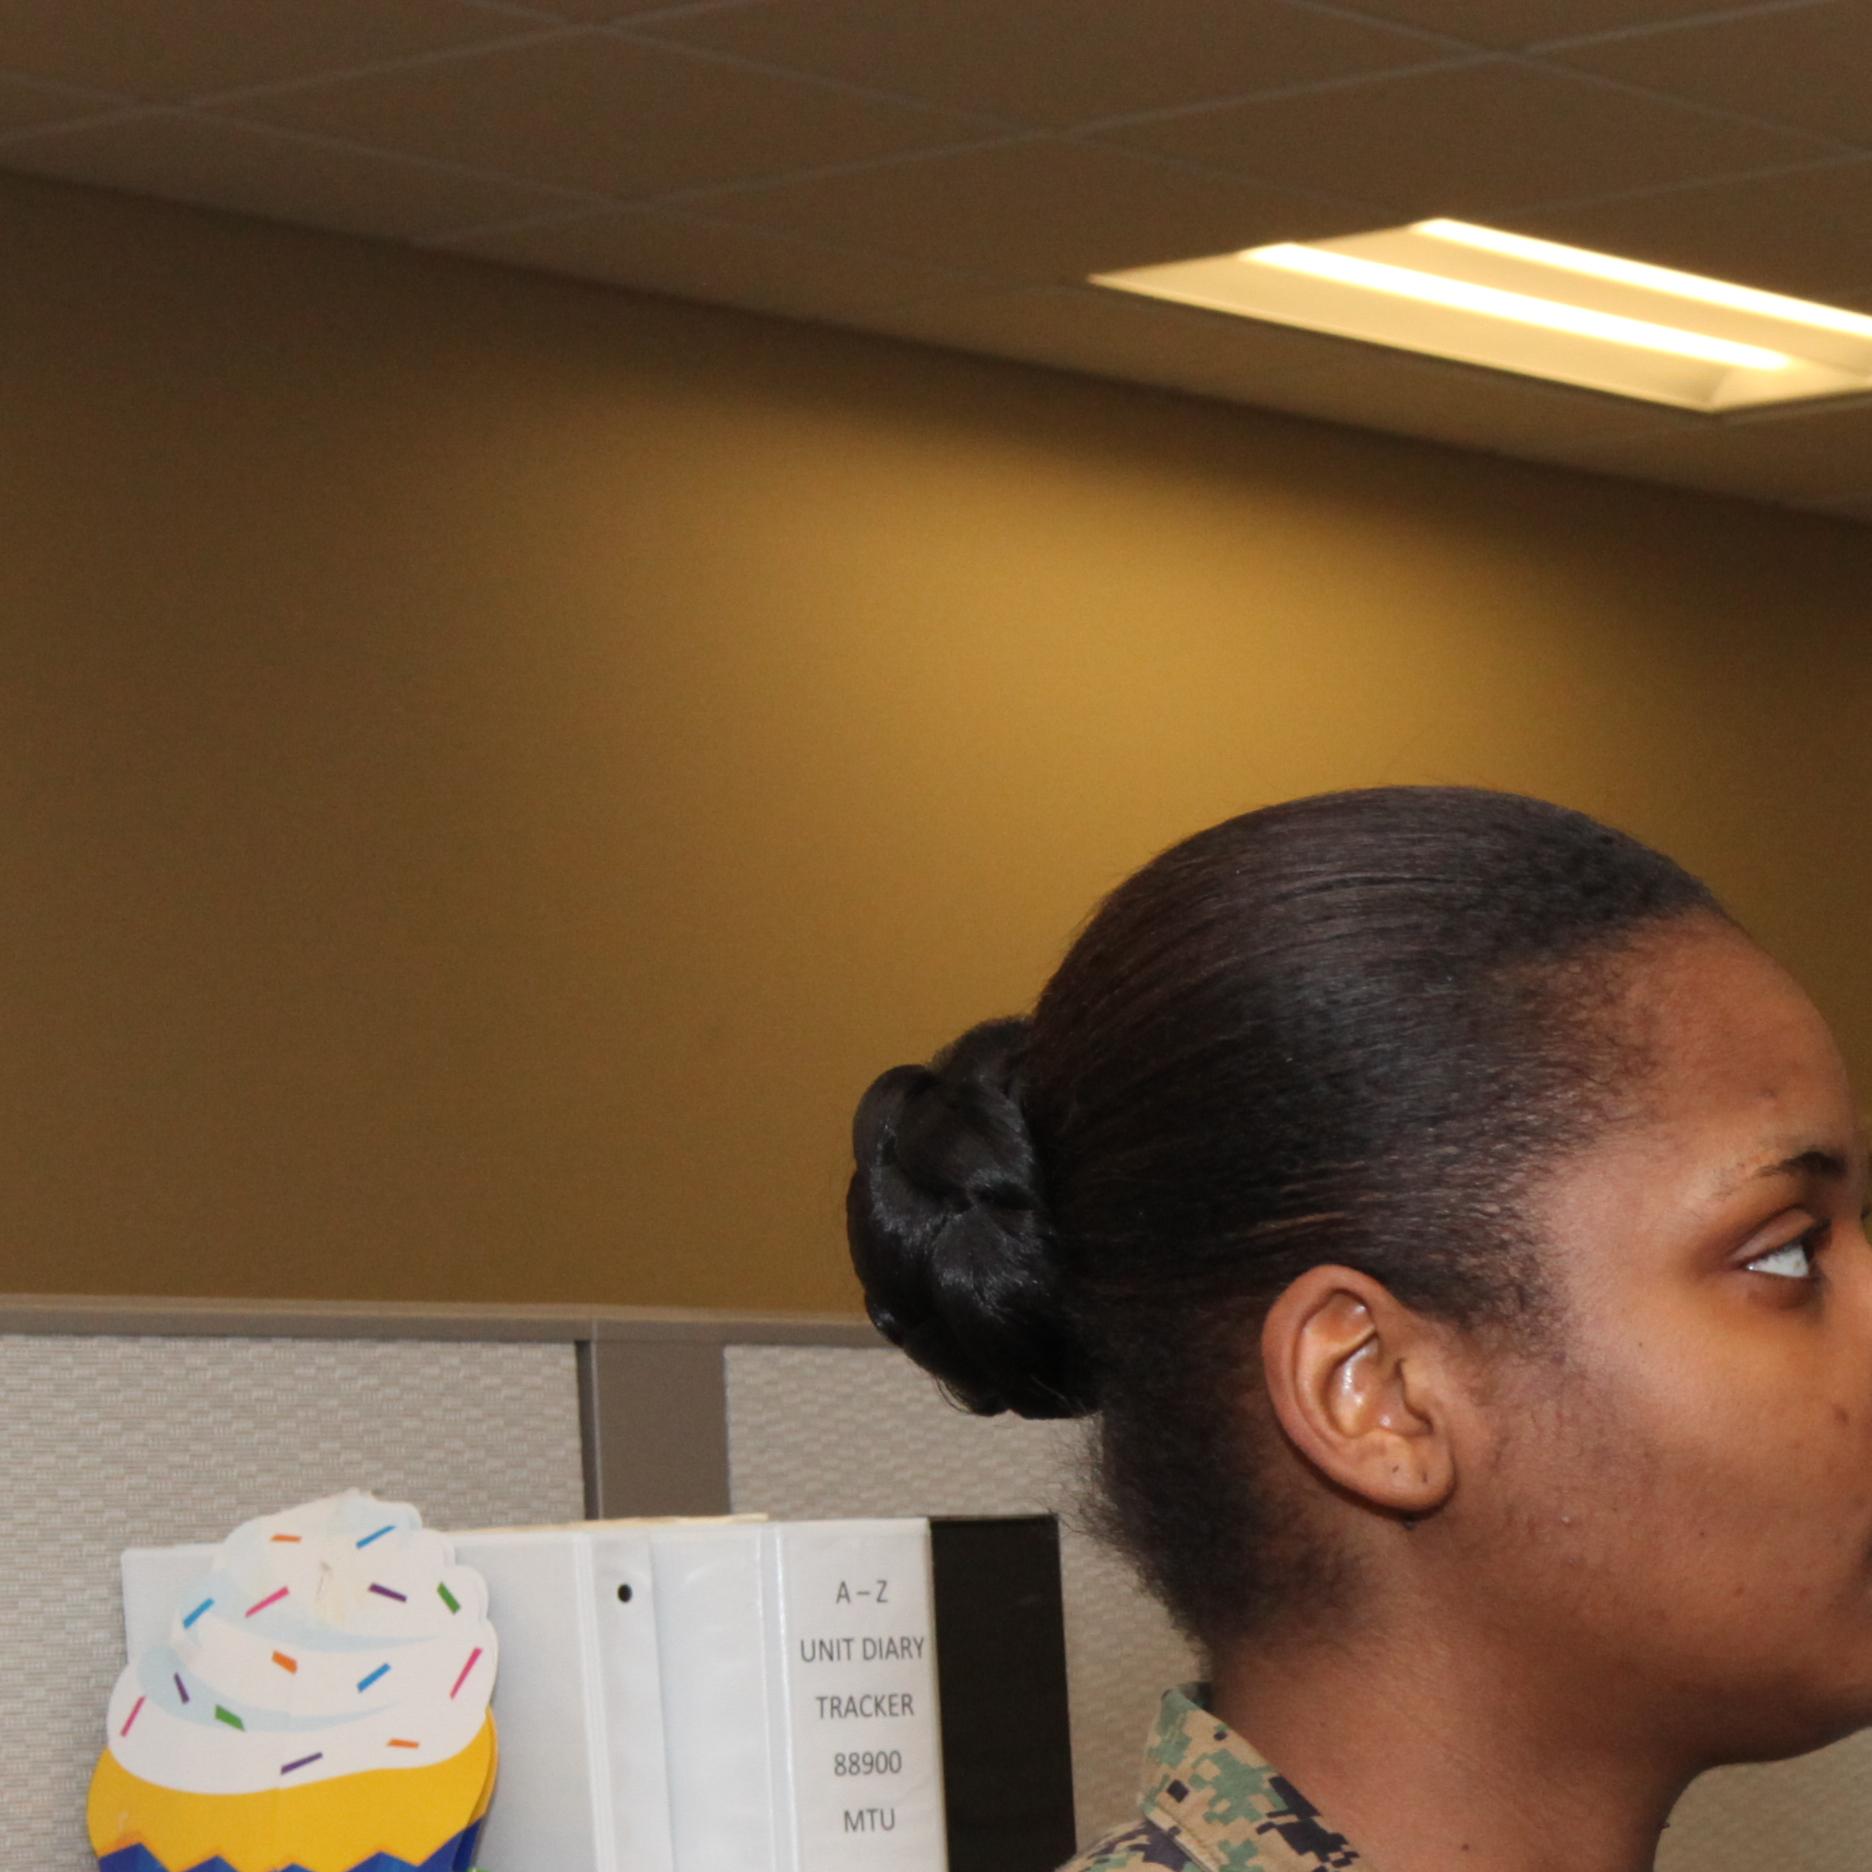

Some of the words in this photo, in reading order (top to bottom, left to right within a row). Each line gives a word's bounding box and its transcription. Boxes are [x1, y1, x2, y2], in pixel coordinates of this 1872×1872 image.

[800, 1638, 855, 1663] UNIT
[862, 1636, 925, 1660] DIARY
[816, 1693, 915, 1719] TRACKER
[834, 1751, 902, 1777] 88900
[843, 1808, 896, 1833] MTU
